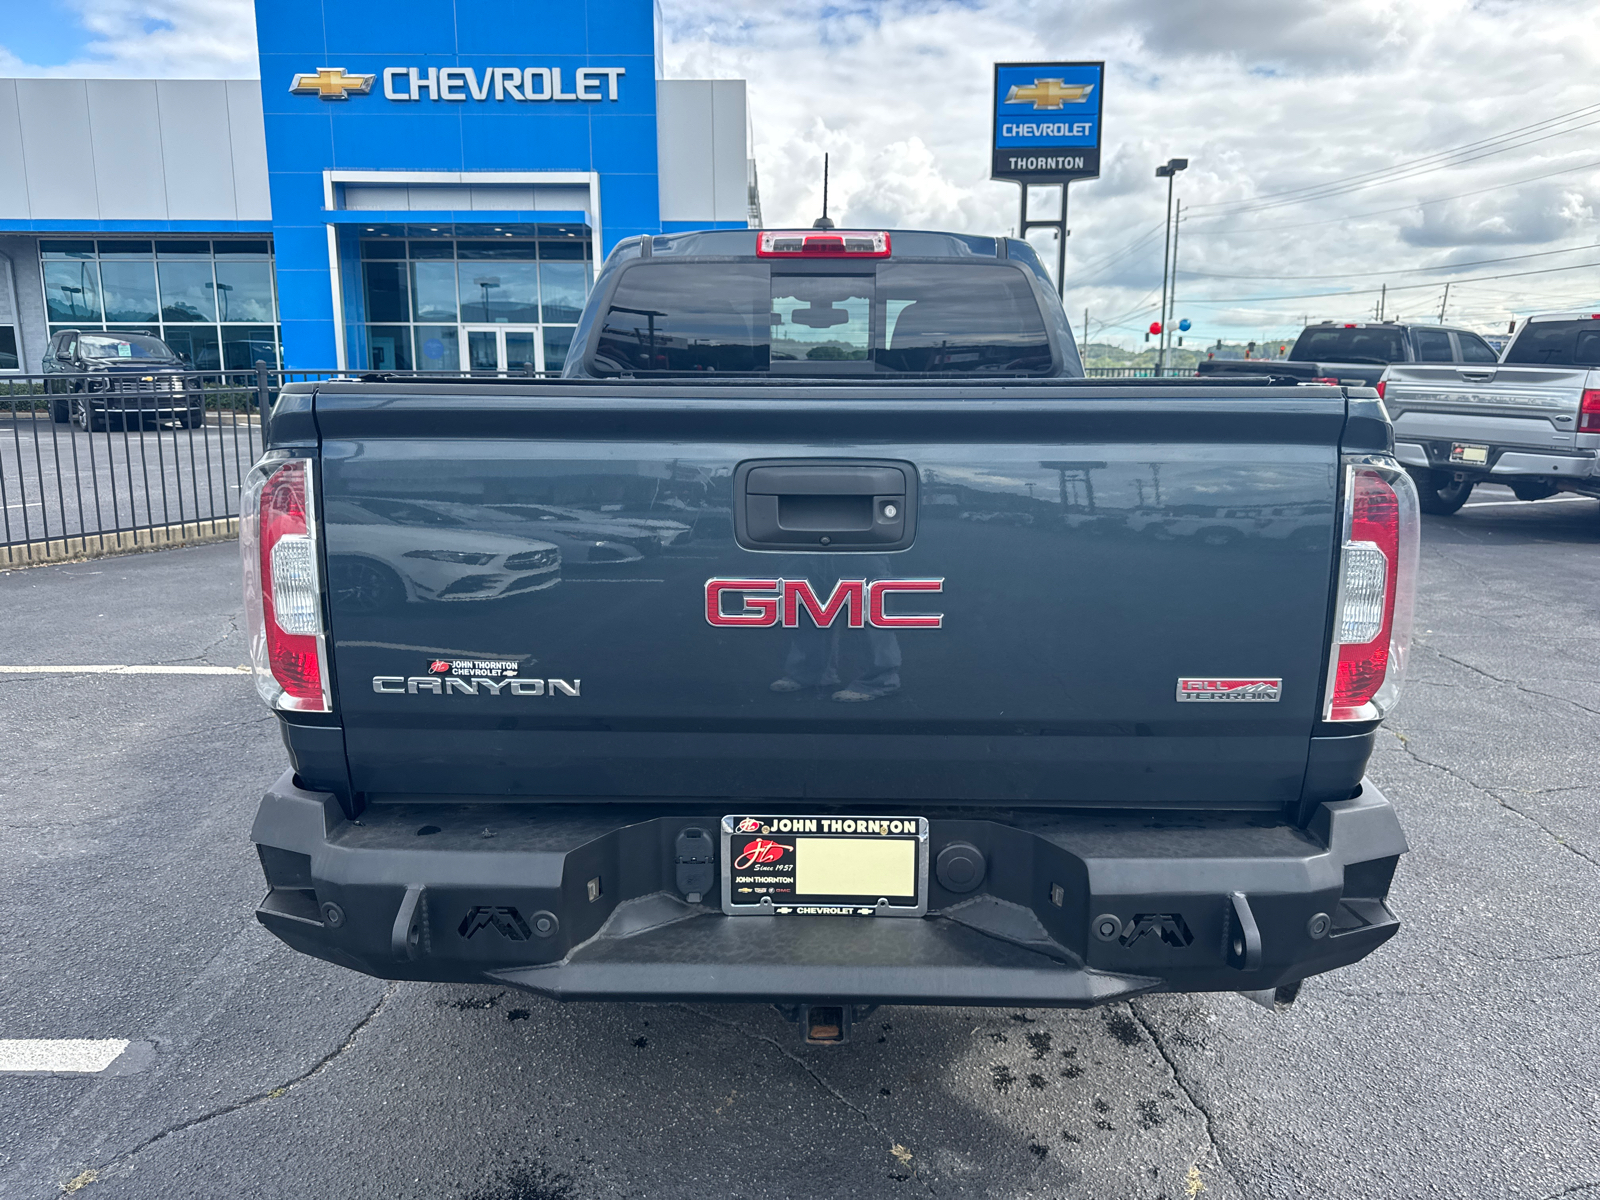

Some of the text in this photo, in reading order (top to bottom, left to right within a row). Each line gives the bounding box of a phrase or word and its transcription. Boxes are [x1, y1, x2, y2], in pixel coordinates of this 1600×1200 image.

[383, 67, 626, 101] CHEVROLET
[1002, 123, 1092, 137] CHEVROLET
[1009, 157, 1084, 169] THORNTON
[705, 577, 945, 629] GMC
[452, 661, 518, 670] JOHN THORNTON
[452, 668, 502, 676] CHEVROLET
[373, 676, 581, 697] CANYON
[1187, 681, 1229, 690] ALL
[1181, 692, 1277, 700] TERRAIN
[771, 819, 916, 834] JOHN THORNTON
[775, 864, 793, 872] 1957
[754, 876, 794, 884] THORNTON
